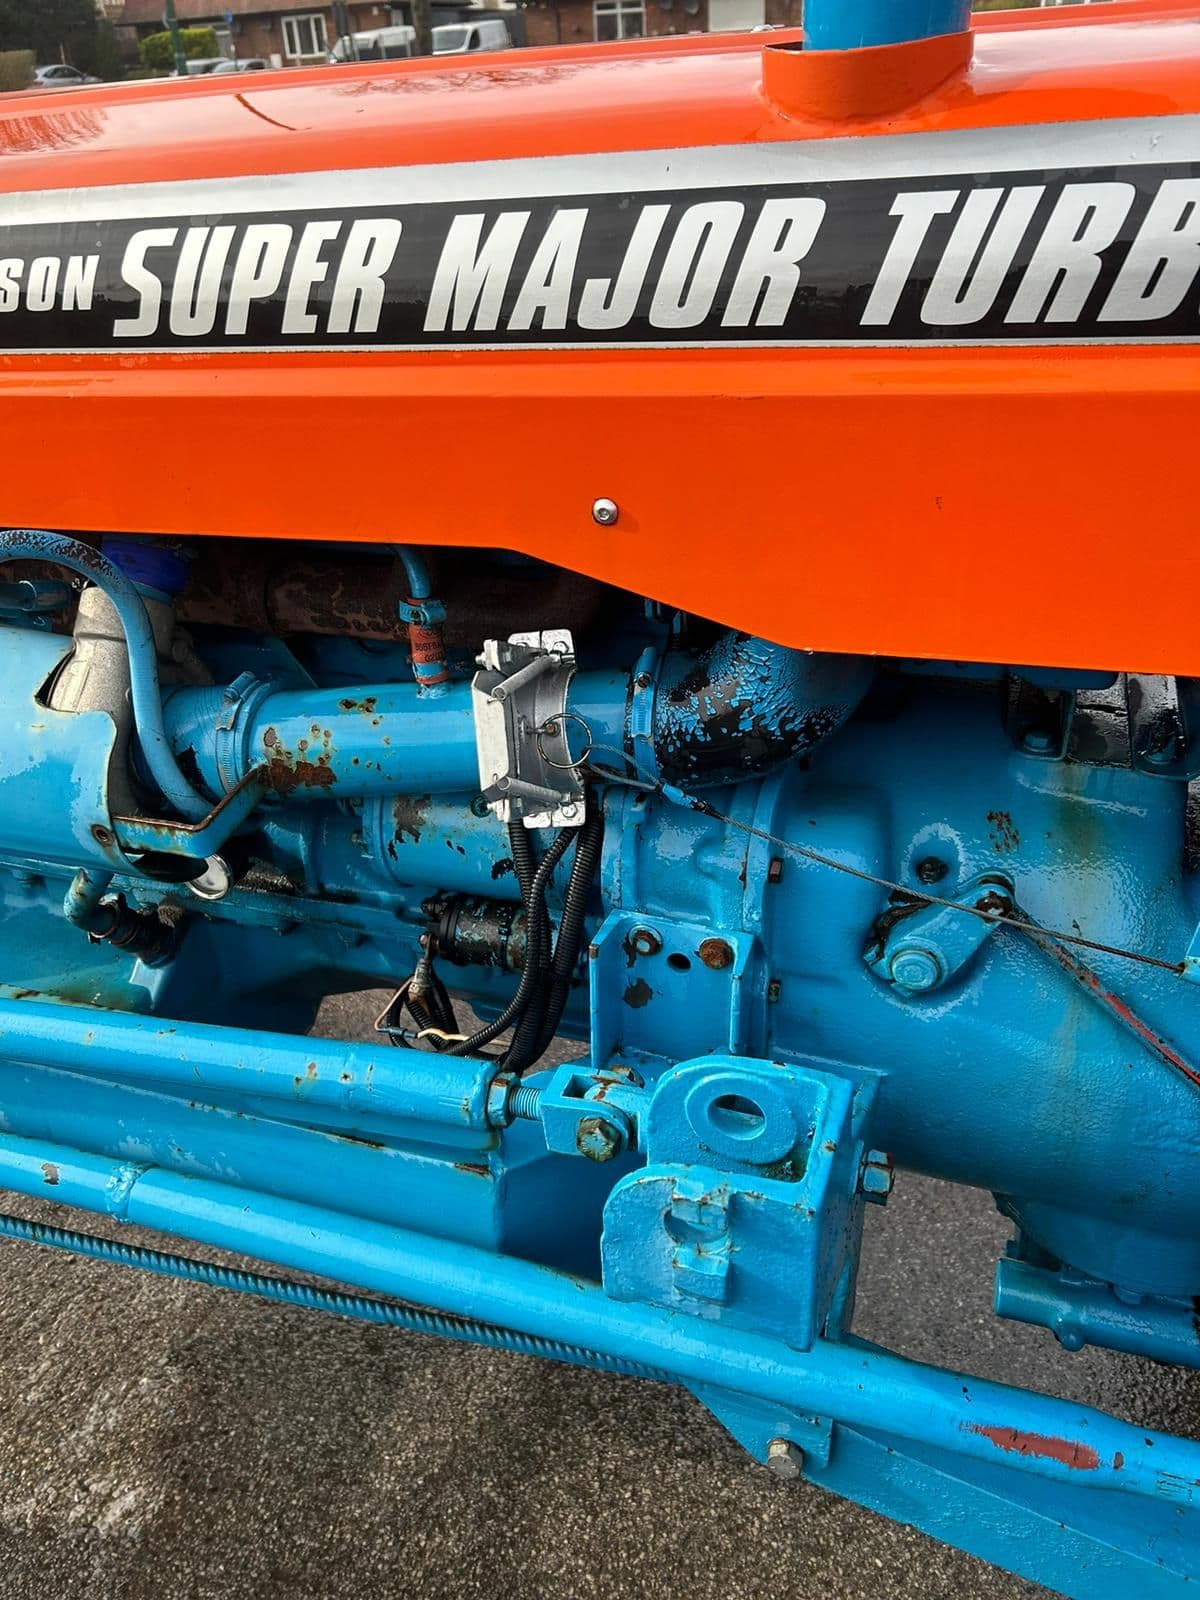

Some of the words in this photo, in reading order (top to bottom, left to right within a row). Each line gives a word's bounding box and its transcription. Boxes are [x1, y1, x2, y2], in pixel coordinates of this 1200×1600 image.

[0, 253, 101, 313] SON
[112, 218, 403, 337] SUPER
[423, 197, 827, 332] MAJOR
